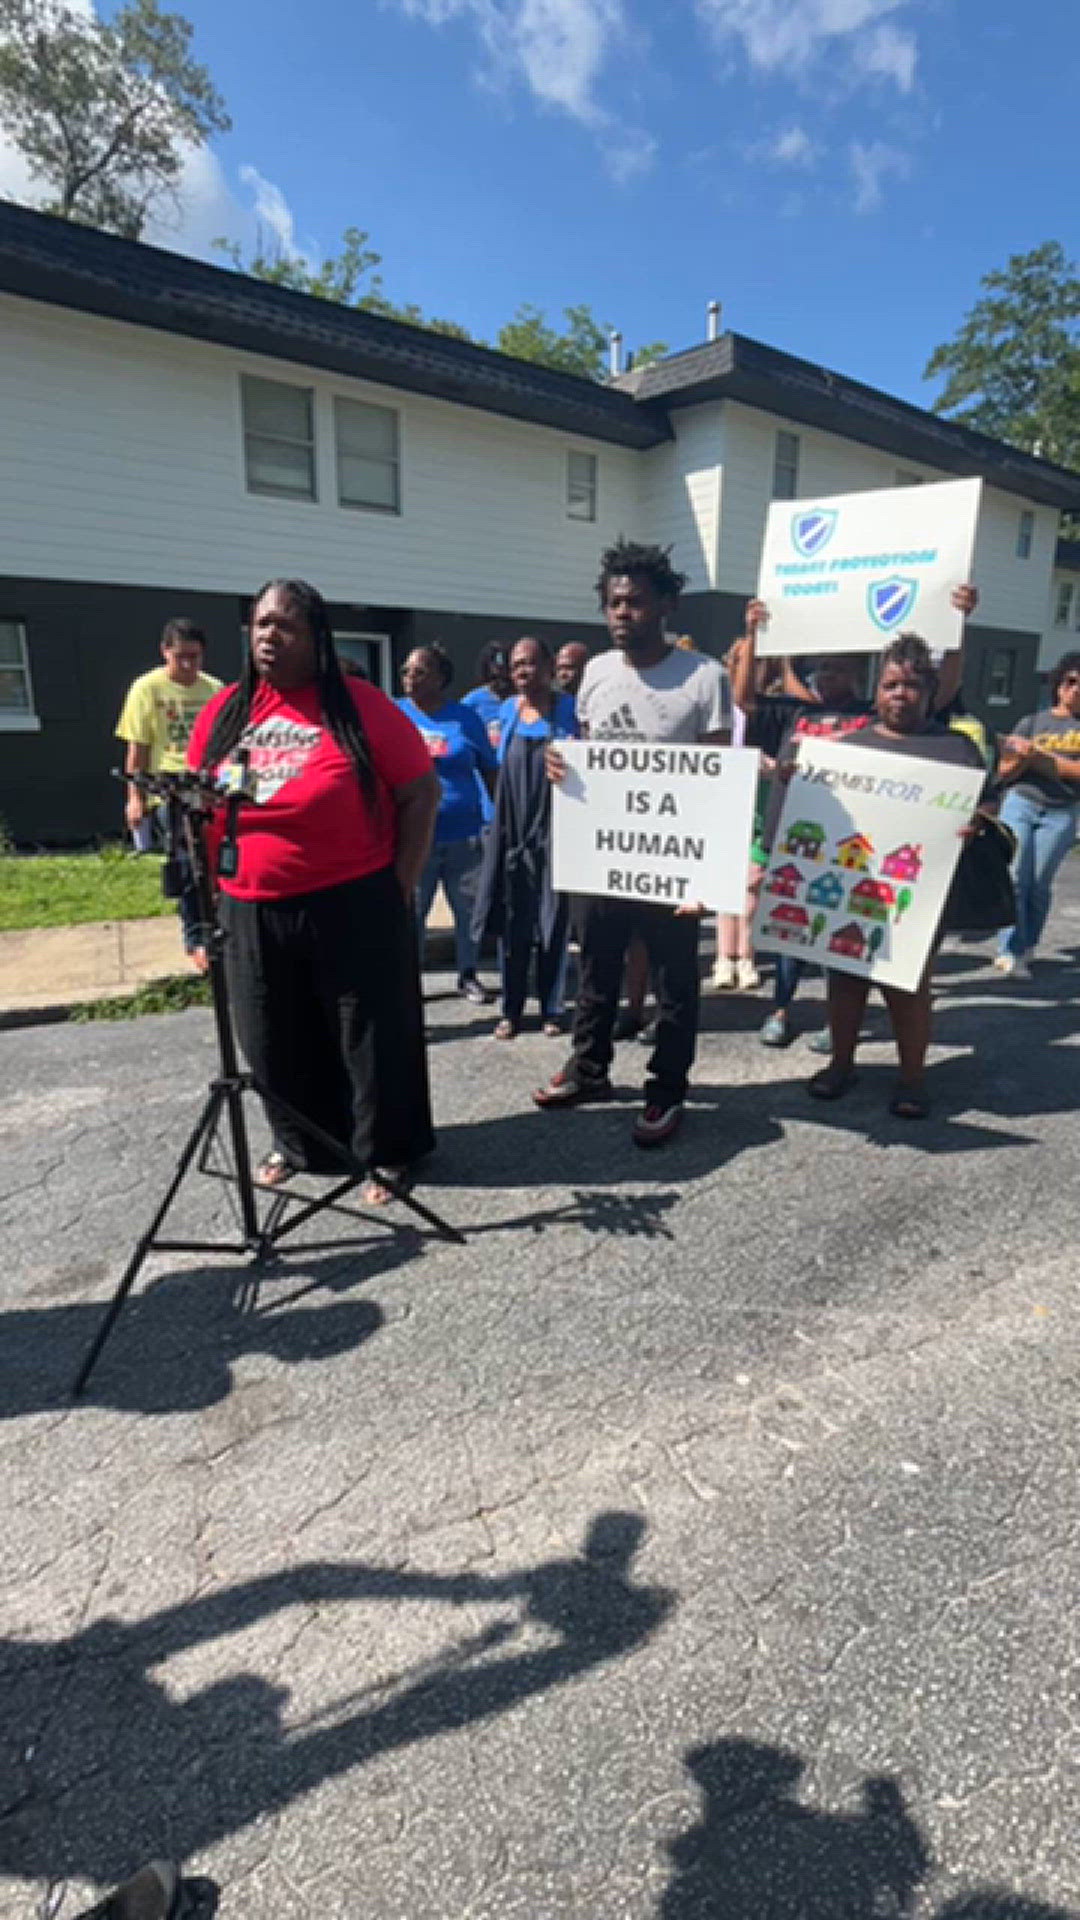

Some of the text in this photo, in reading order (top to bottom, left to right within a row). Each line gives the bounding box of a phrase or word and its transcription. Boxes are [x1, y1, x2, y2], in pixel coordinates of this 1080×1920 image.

[587, 748, 722, 776] HOUSING
[625, 790, 678, 816] IS A
[875, 778, 923, 803] FOR
[929, 790, 975, 811] ALL
[595, 829, 704, 860] HUMAN
[607, 868, 689, 899] RIGHT
